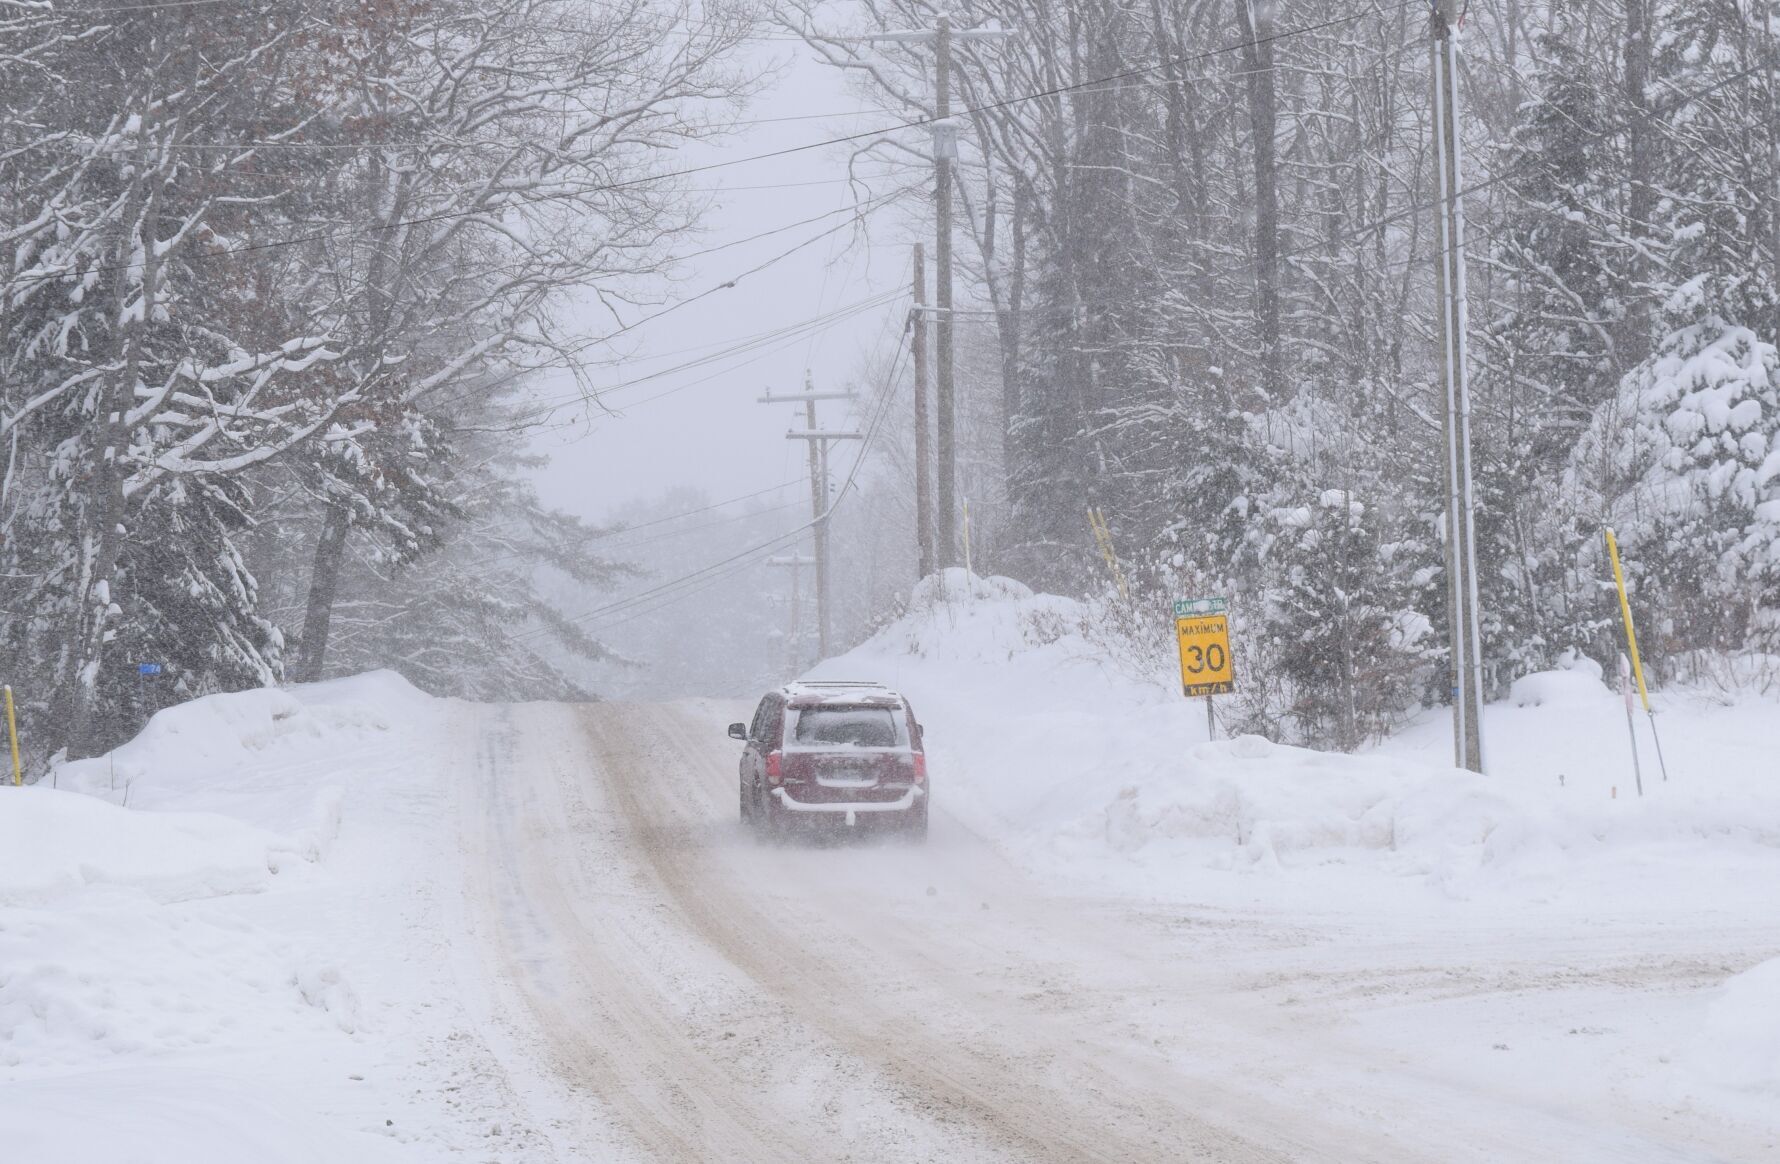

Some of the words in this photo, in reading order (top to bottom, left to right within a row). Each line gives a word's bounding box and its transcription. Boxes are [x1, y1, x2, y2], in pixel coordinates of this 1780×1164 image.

[1182, 624, 1224, 635] MAXIMUM
[1187, 644, 1225, 673] 30
[1190, 683, 1227, 696] km/h
